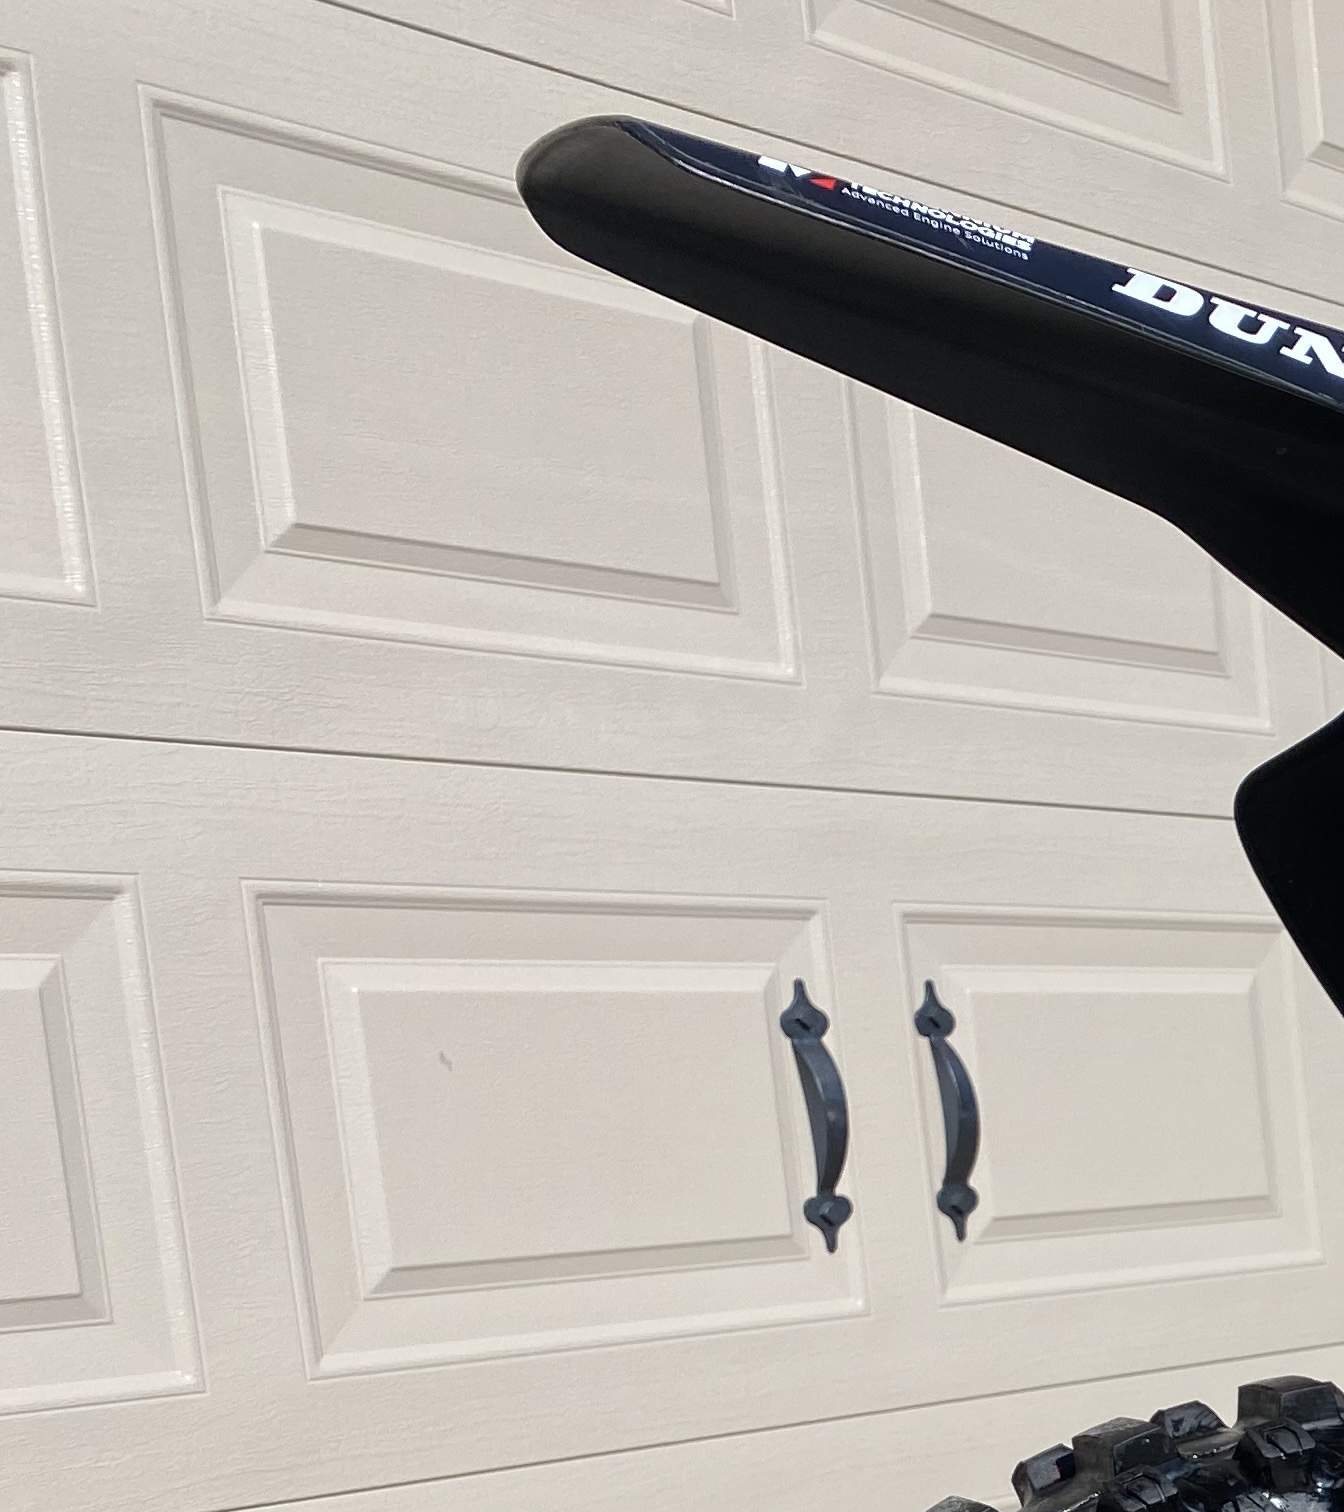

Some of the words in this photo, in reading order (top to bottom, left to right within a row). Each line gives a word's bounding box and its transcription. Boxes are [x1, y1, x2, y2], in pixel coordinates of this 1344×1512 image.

[841, 187, 910, 217] Advanced
[913, 210, 961, 236] Engine
[963, 231, 1030, 261] Solutions
